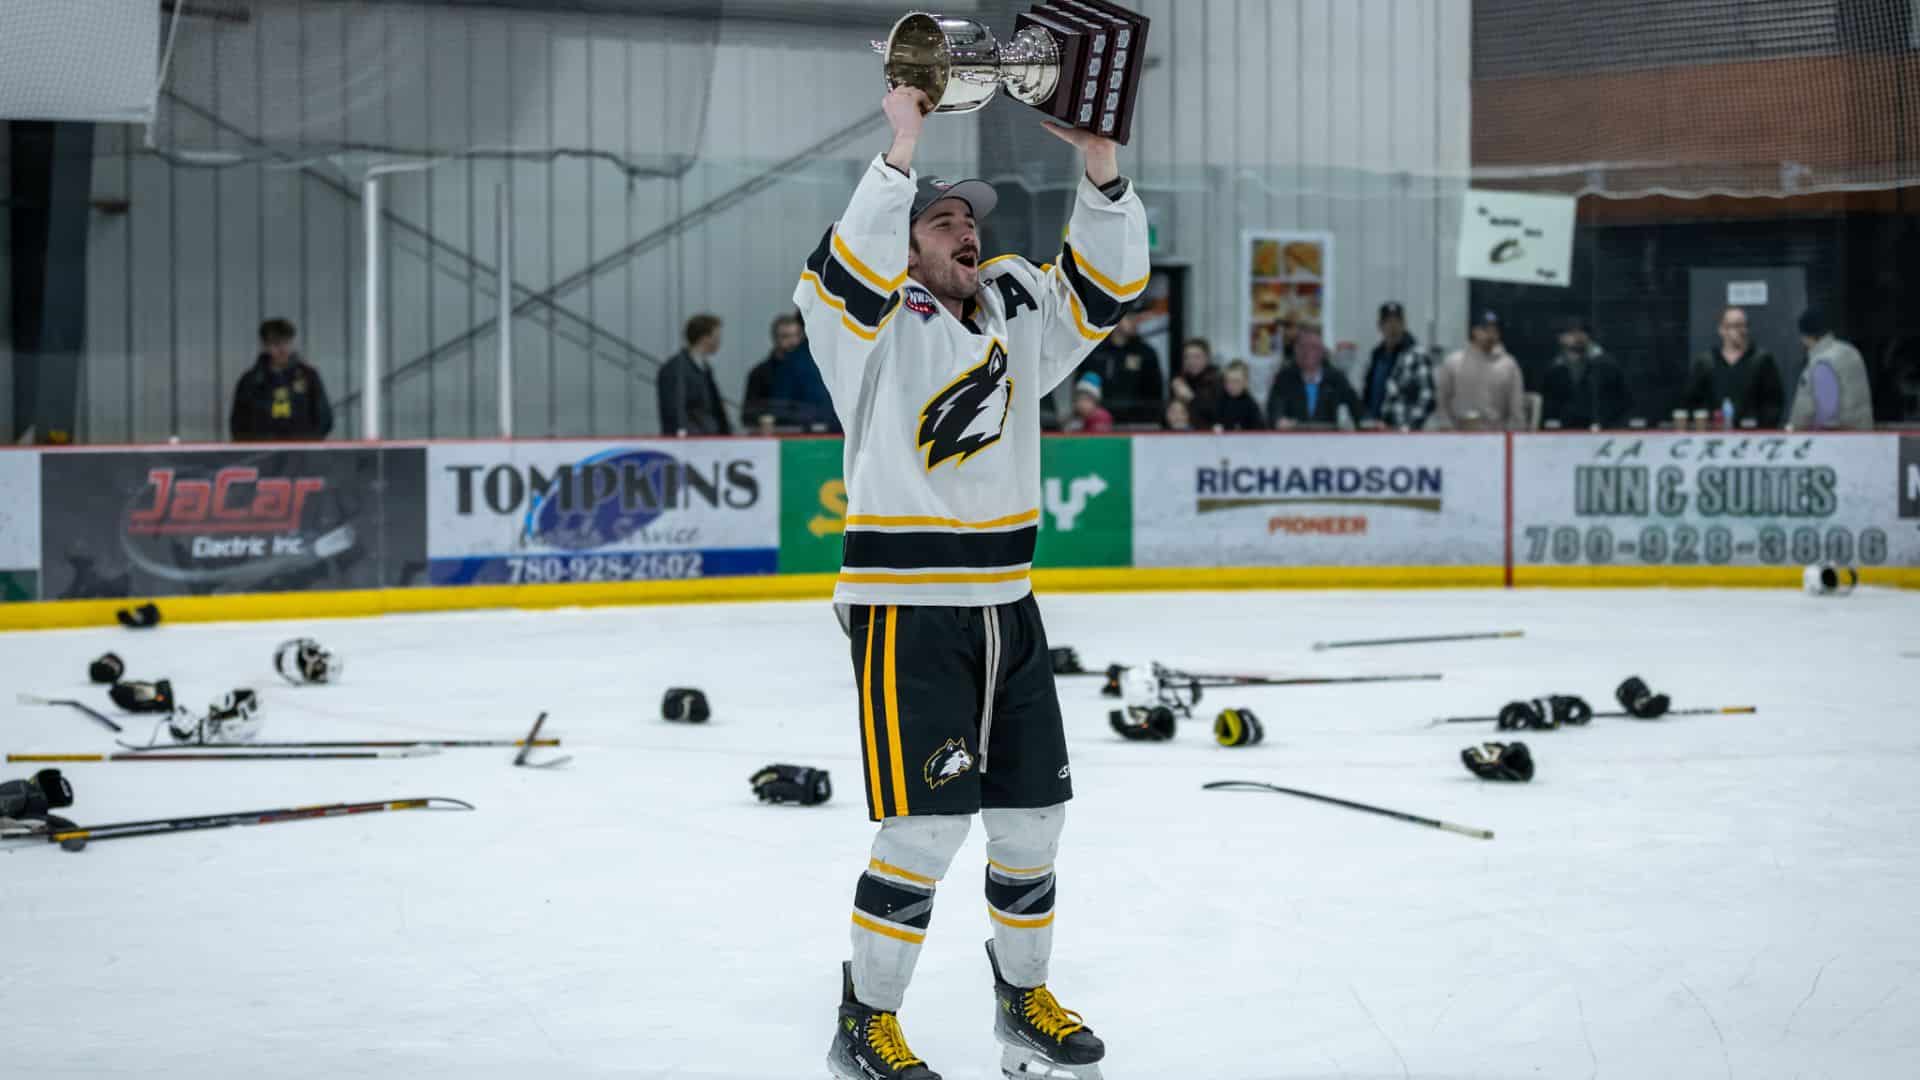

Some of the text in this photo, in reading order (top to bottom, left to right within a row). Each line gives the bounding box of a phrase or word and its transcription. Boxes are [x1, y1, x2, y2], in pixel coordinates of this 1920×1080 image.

[995, 271, 1038, 321] A
[128, 466, 324, 532] JaCar
[445, 459, 759, 515] TOMPKINS
[1575, 465, 1837, 518] INN & SUITES
[191, 535, 266, 559] Electric
[1268, 515, 1367, 535] PIONEER
[1525, 525, 1889, 565] 780-928-3806
[507, 552, 702, 584] 780-928-2602
